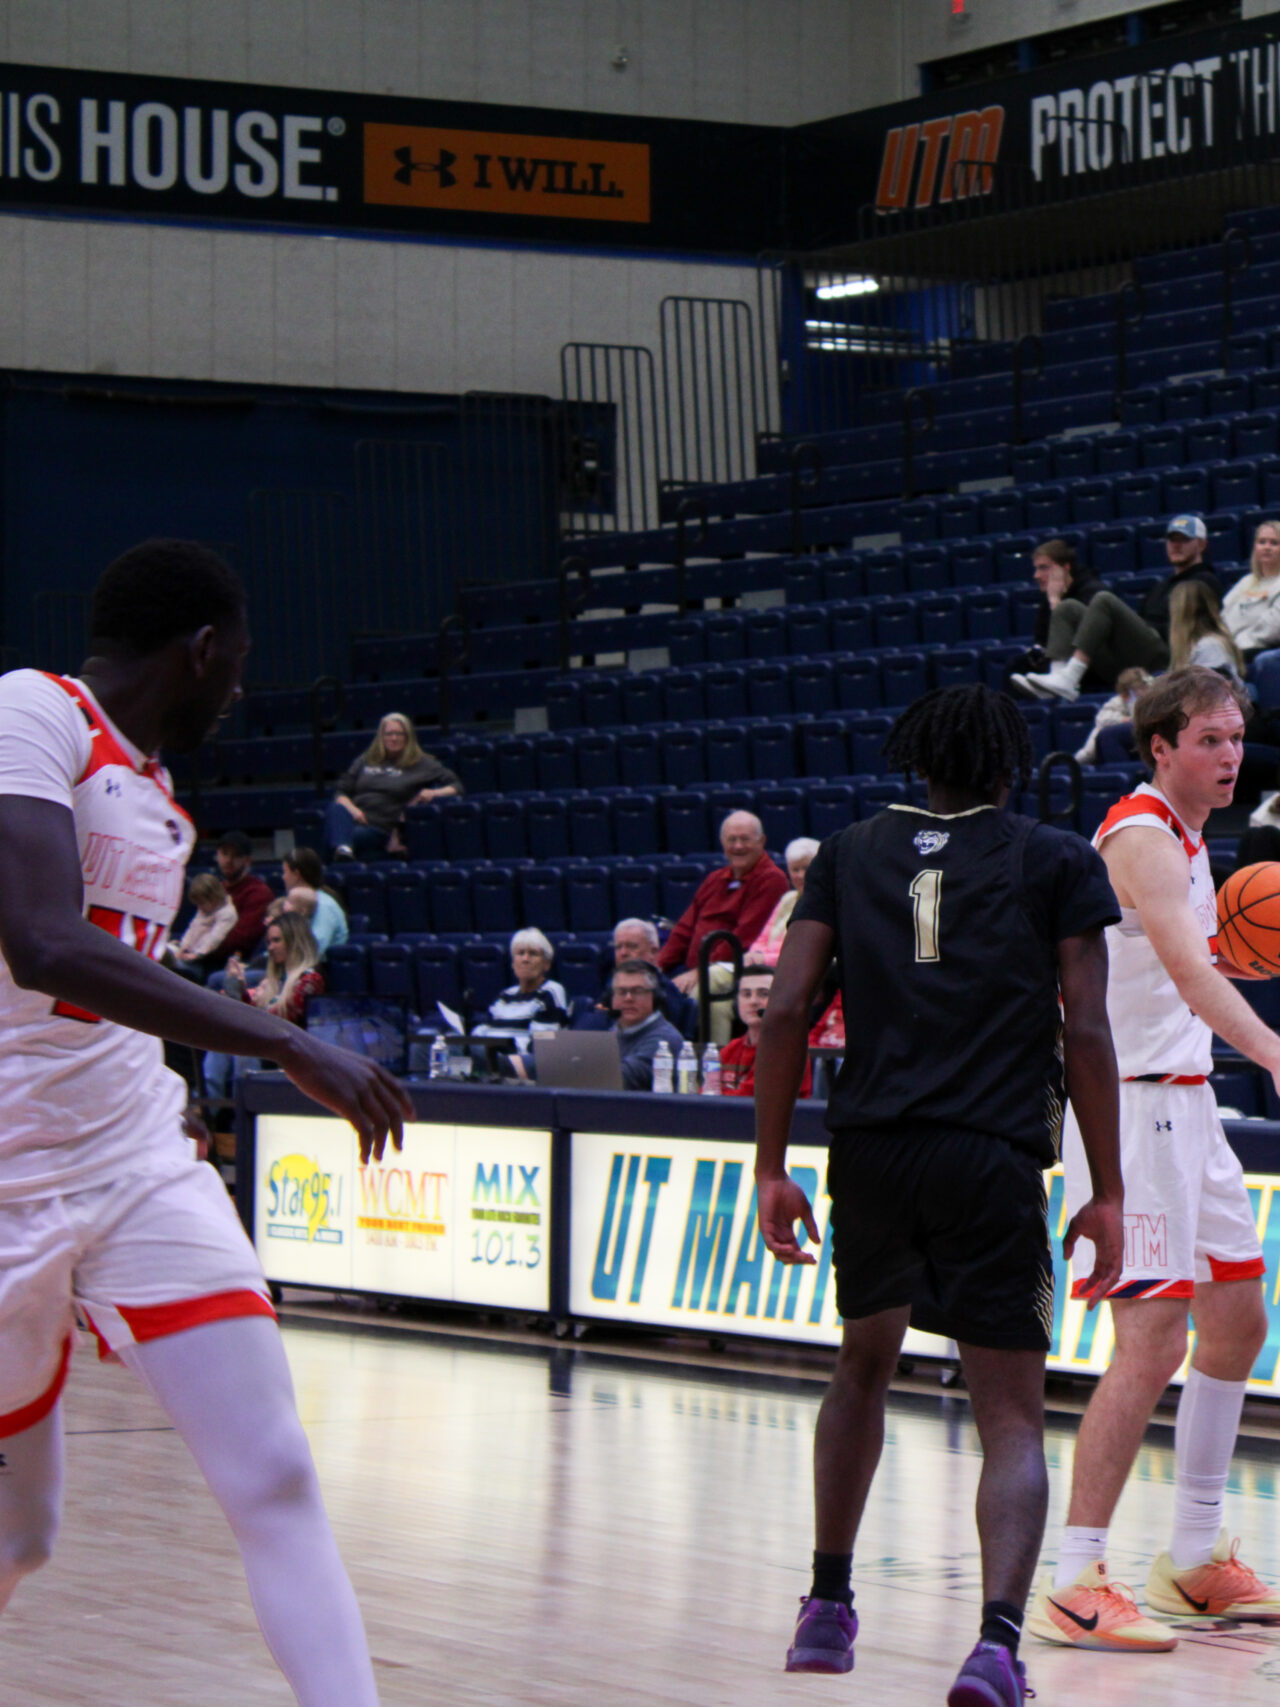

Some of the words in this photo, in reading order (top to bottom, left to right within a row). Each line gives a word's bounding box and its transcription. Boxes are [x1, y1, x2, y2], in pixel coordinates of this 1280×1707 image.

[0, 91, 61, 182] IS
[1031, 57, 1222, 182] PROTECT
[474, 154, 492, 189] I
[875, 105, 1005, 215] UTM
[909, 869, 944, 963] 1
[358, 1167, 448, 1220] WCMT
[472, 1162, 540, 1207] MIX
[471, 1229, 542, 1269] 101.3
[590, 1152, 673, 1306] UT
[1122, 1213, 1168, 1268] TM
